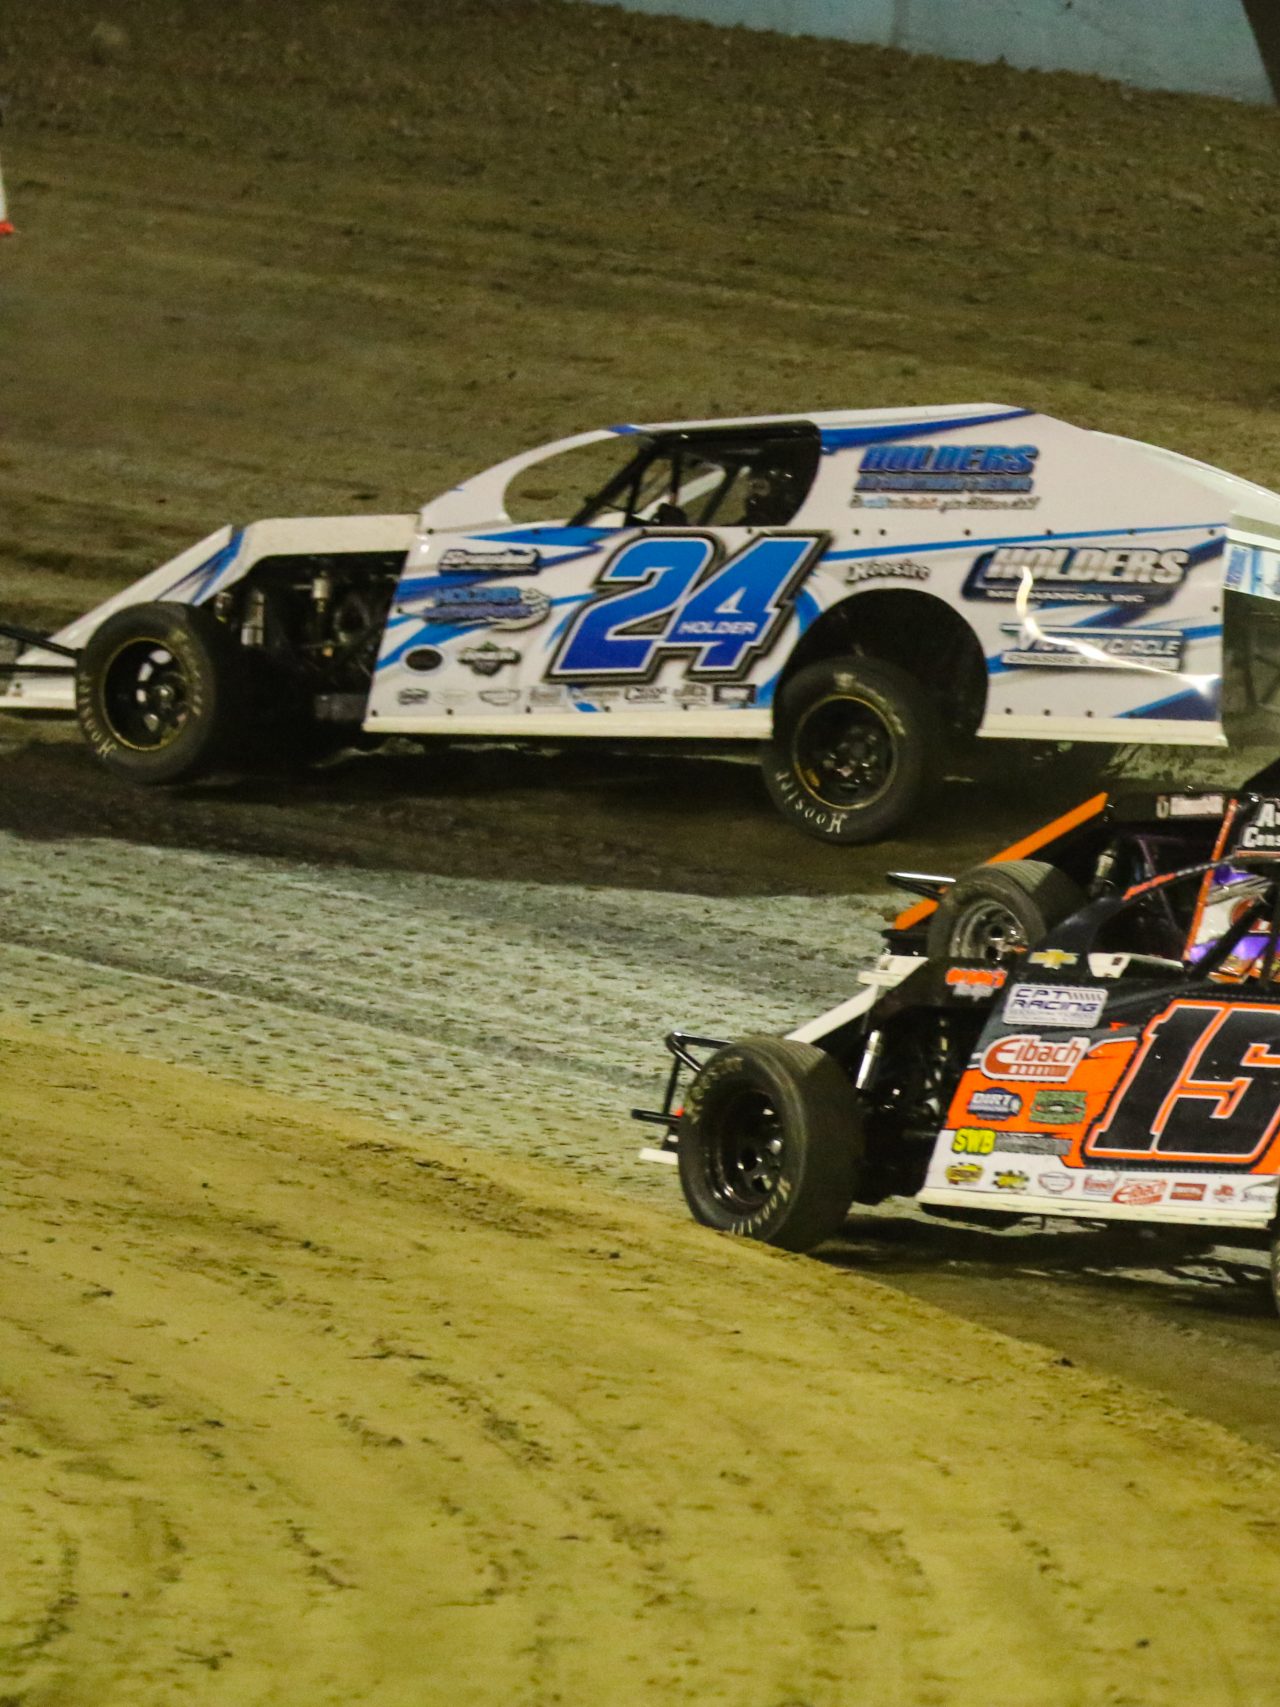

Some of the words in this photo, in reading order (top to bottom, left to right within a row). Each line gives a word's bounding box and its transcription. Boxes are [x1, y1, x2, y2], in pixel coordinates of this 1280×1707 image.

[859, 445, 1040, 474] HOLDERS
[984, 547, 1191, 584] HOLDERS
[541, 529, 832, 682] 24
[987, 589, 1109, 602] MEHANICAL
[678, 621, 757, 635] HOLDER
[1010, 1000, 1099, 1012] RACING
[984, 1036, 1083, 1076] Eibach
